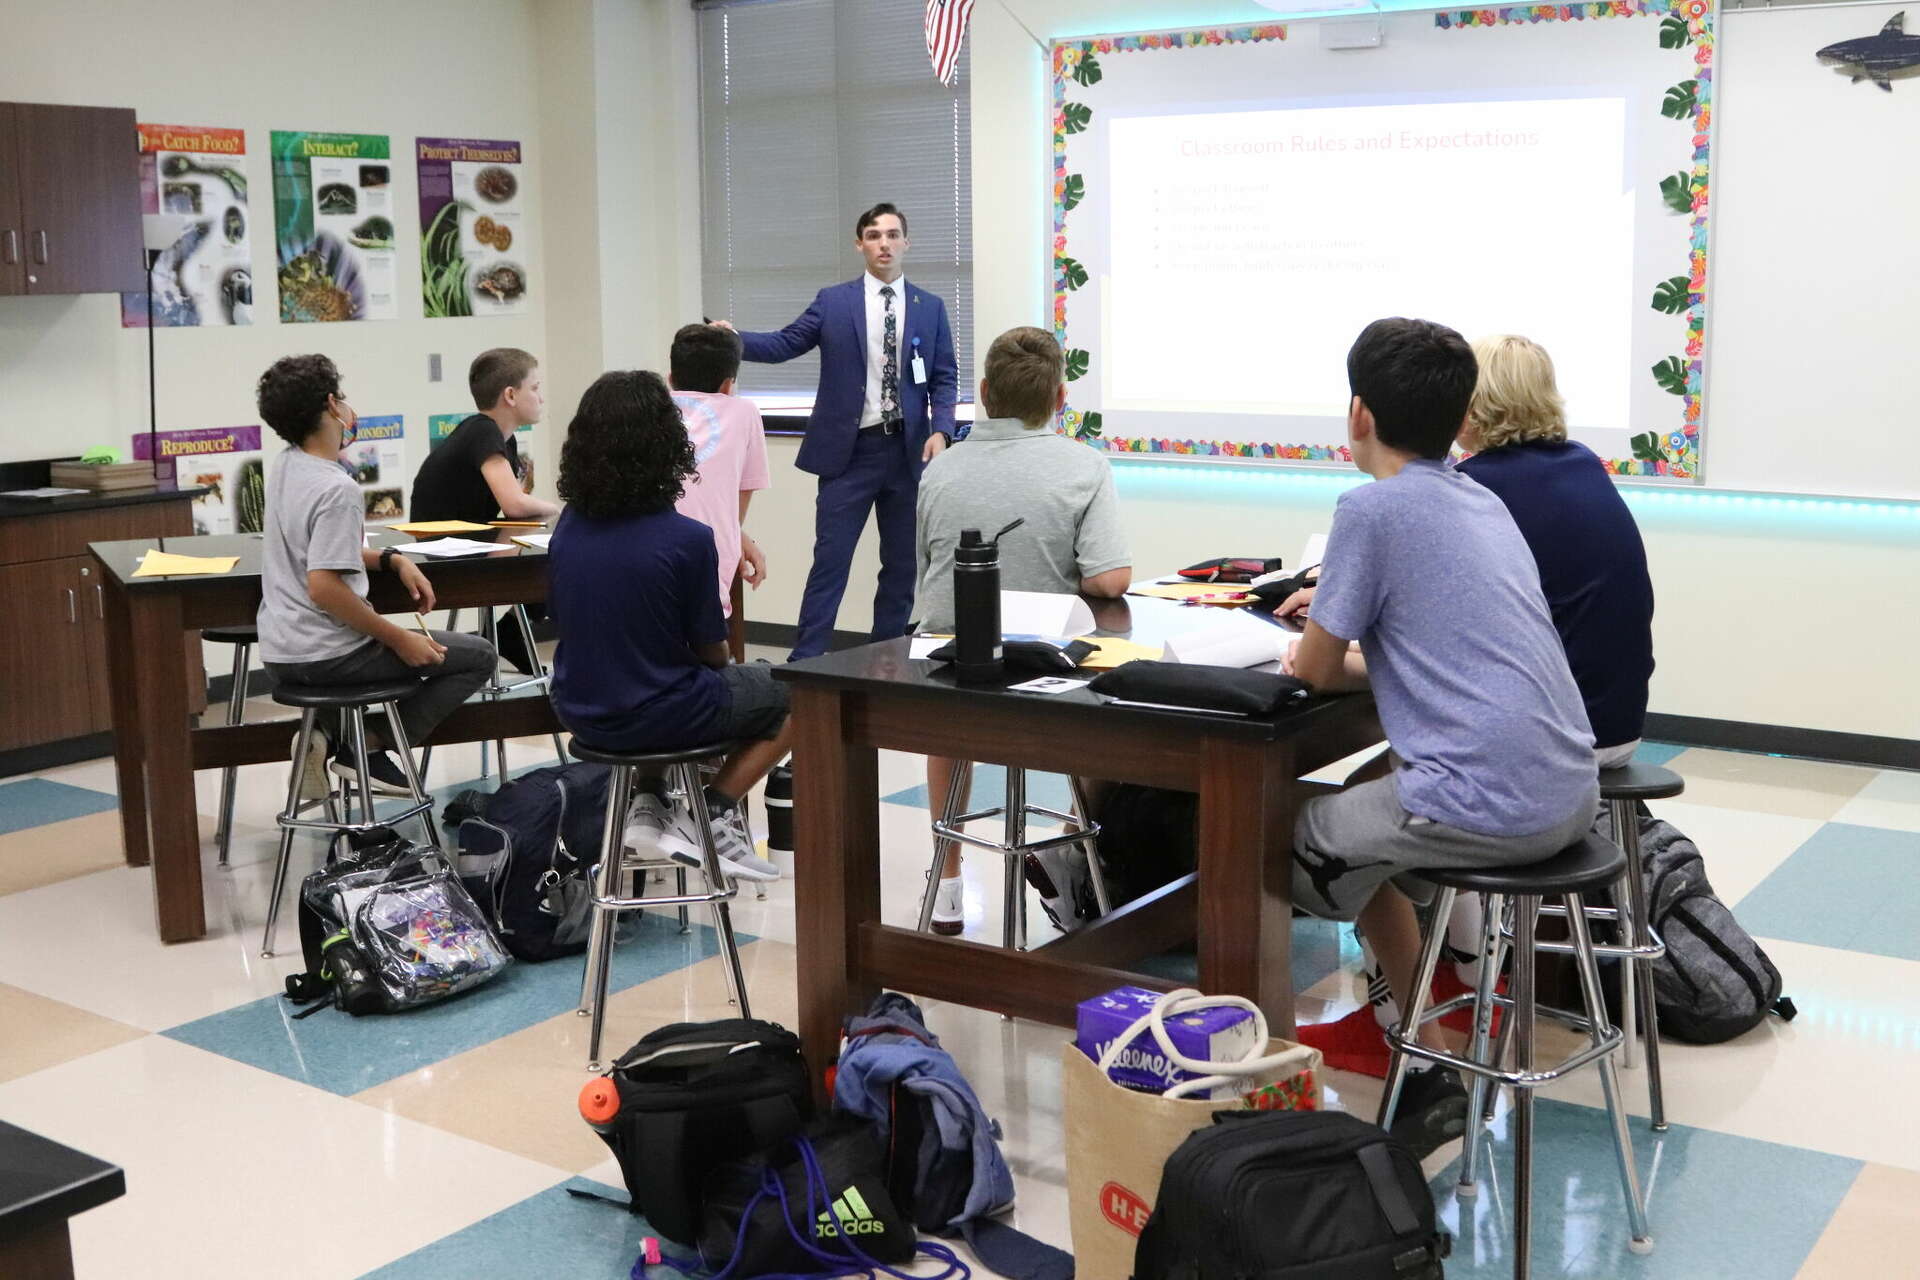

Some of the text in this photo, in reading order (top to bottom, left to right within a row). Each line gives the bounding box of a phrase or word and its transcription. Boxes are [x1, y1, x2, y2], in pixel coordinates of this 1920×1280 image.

[162, 132, 199, 150] CATCH
[202, 134, 240, 152] FOOD?
[303, 139, 359, 157] INTERACT?
[420, 143, 459, 160] PROTECT
[1179, 128, 1540, 158] Classroom Rules and Expectations
[356, 422, 400, 439] ONMENT?
[161, 435, 235, 456] REPRODUCE?
[815, 1219, 885, 1239] addas
